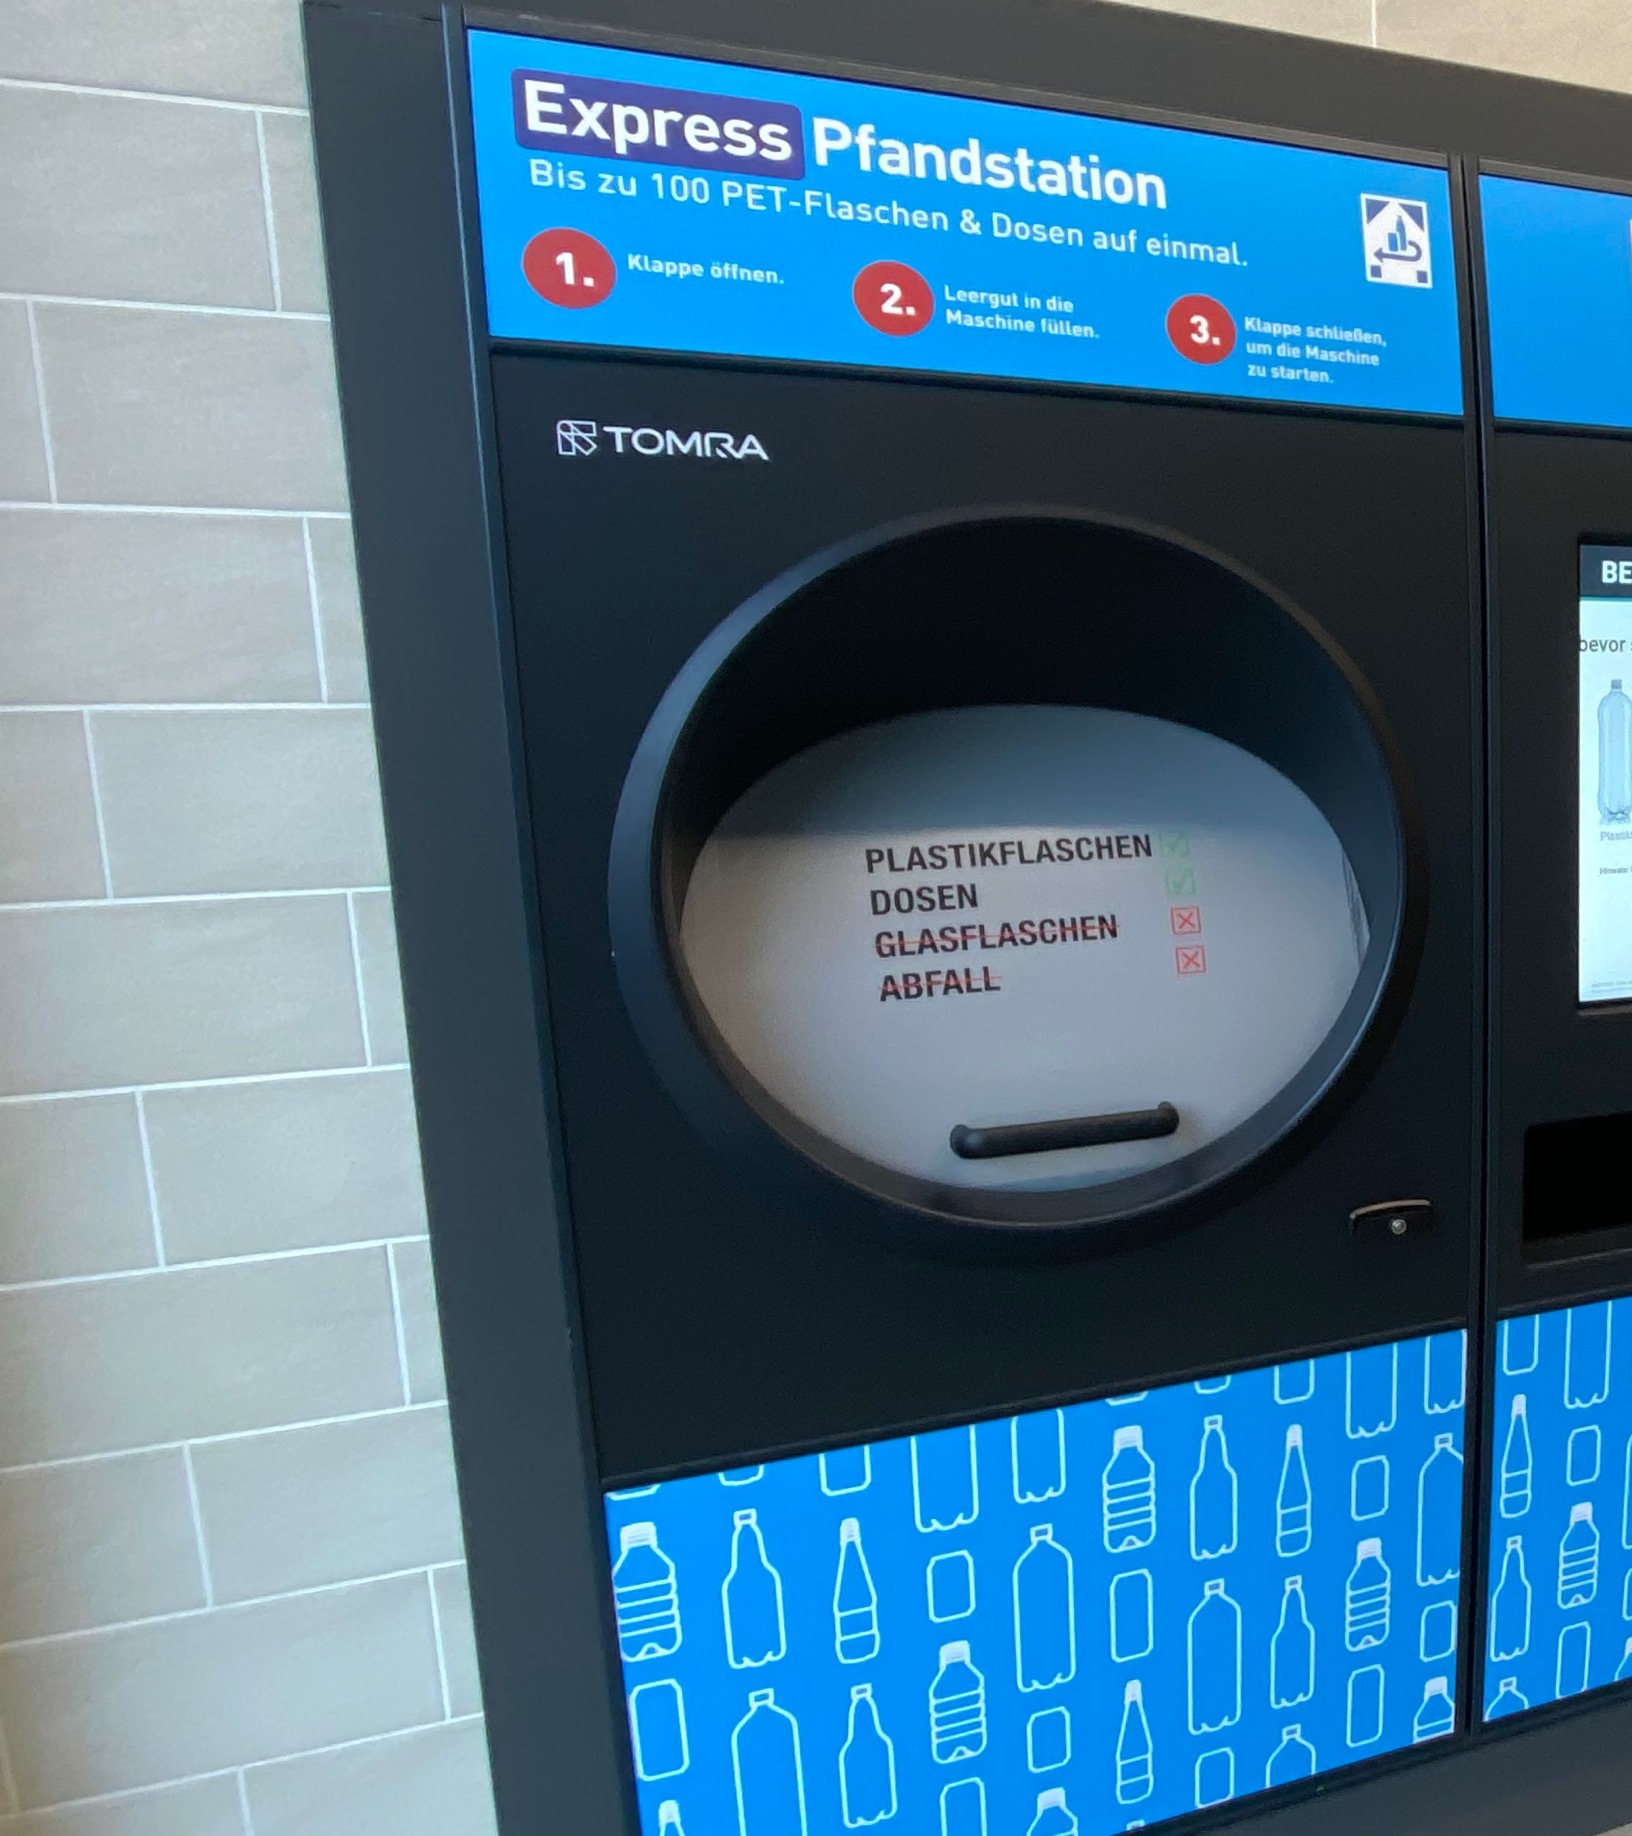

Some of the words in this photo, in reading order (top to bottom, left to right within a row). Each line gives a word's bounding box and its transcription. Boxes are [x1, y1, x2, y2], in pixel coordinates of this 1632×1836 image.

[523, 78, 793, 162] Express
[813, 115, 1168, 210] Pfandstation
[530, 158, 586, 191] Bis
[598, 175, 637, 198] zu
[652, 172, 710, 204] 100
[722, 181, 949, 232] PET-Flaschen
[960, 209, 982, 236] &
[992, 213, 1083, 247] Dosen
[1093, 229, 1137, 256] auf
[1146, 233, 1248, 267] einmal.
[555, 252, 595, 287] 1.
[628, 254, 704, 280] Klappe
[711, 261, 784, 284] öffnen.
[880, 283, 916, 316] 2.
[945, 285, 1020, 312] Leergut
[1025, 293, 1041, 310] in
[1046, 295, 1074, 313] die
[946, 311, 1035, 333] Maschine
[1040, 317, 1100, 339] füllen.
[1190, 315, 1220, 345] 3.
[1245, 316, 1301, 339] Klappe
[1306, 321, 1387, 347] schließen,
[1247, 342, 1272, 356] um
[1276, 341, 1301, 358] die
[1306, 344, 1379, 366] Maschine
[1248, 366, 1267, 379] zu
[1271, 365, 1334, 384] starten.
[603, 426, 769, 460] TOMRA
[1579, 634, 1626, 653] bevor
[865, 834, 1153, 873] PLASTIKFLASCHEN
[870, 884, 978, 916] DOSEN
[875, 914, 1119, 959] GLASFLASCHEN
[879, 966, 1001, 1002] ABFALL
